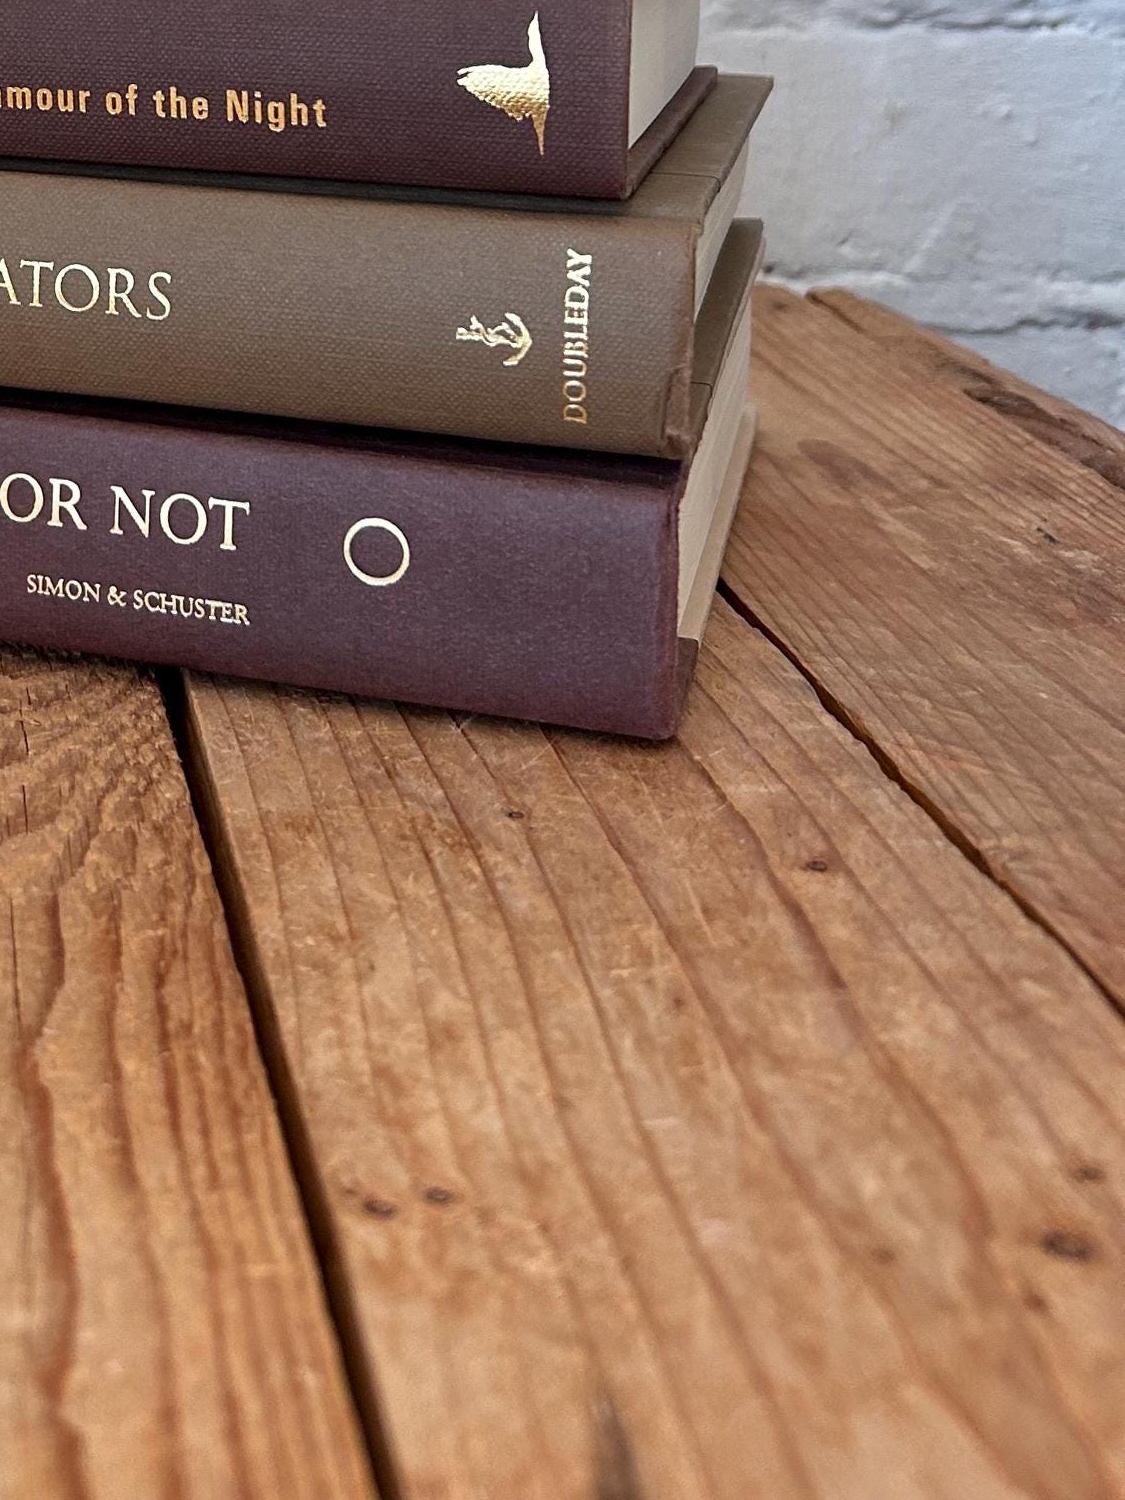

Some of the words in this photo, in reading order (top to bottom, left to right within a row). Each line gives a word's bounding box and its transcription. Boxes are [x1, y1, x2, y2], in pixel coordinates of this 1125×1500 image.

[105, 83, 140, 117] of
[152, 85, 209, 121] the
[225, 89, 328, 134] Night
[562, 248, 593, 426] DOUBLEDAY
[0, 472, 88, 532] OR
[107, 485, 251, 552] NOT
[25, 573, 102, 605] SIMON
[106, 584, 129, 608] &
[131, 588, 251, 627] SCHUSTER
